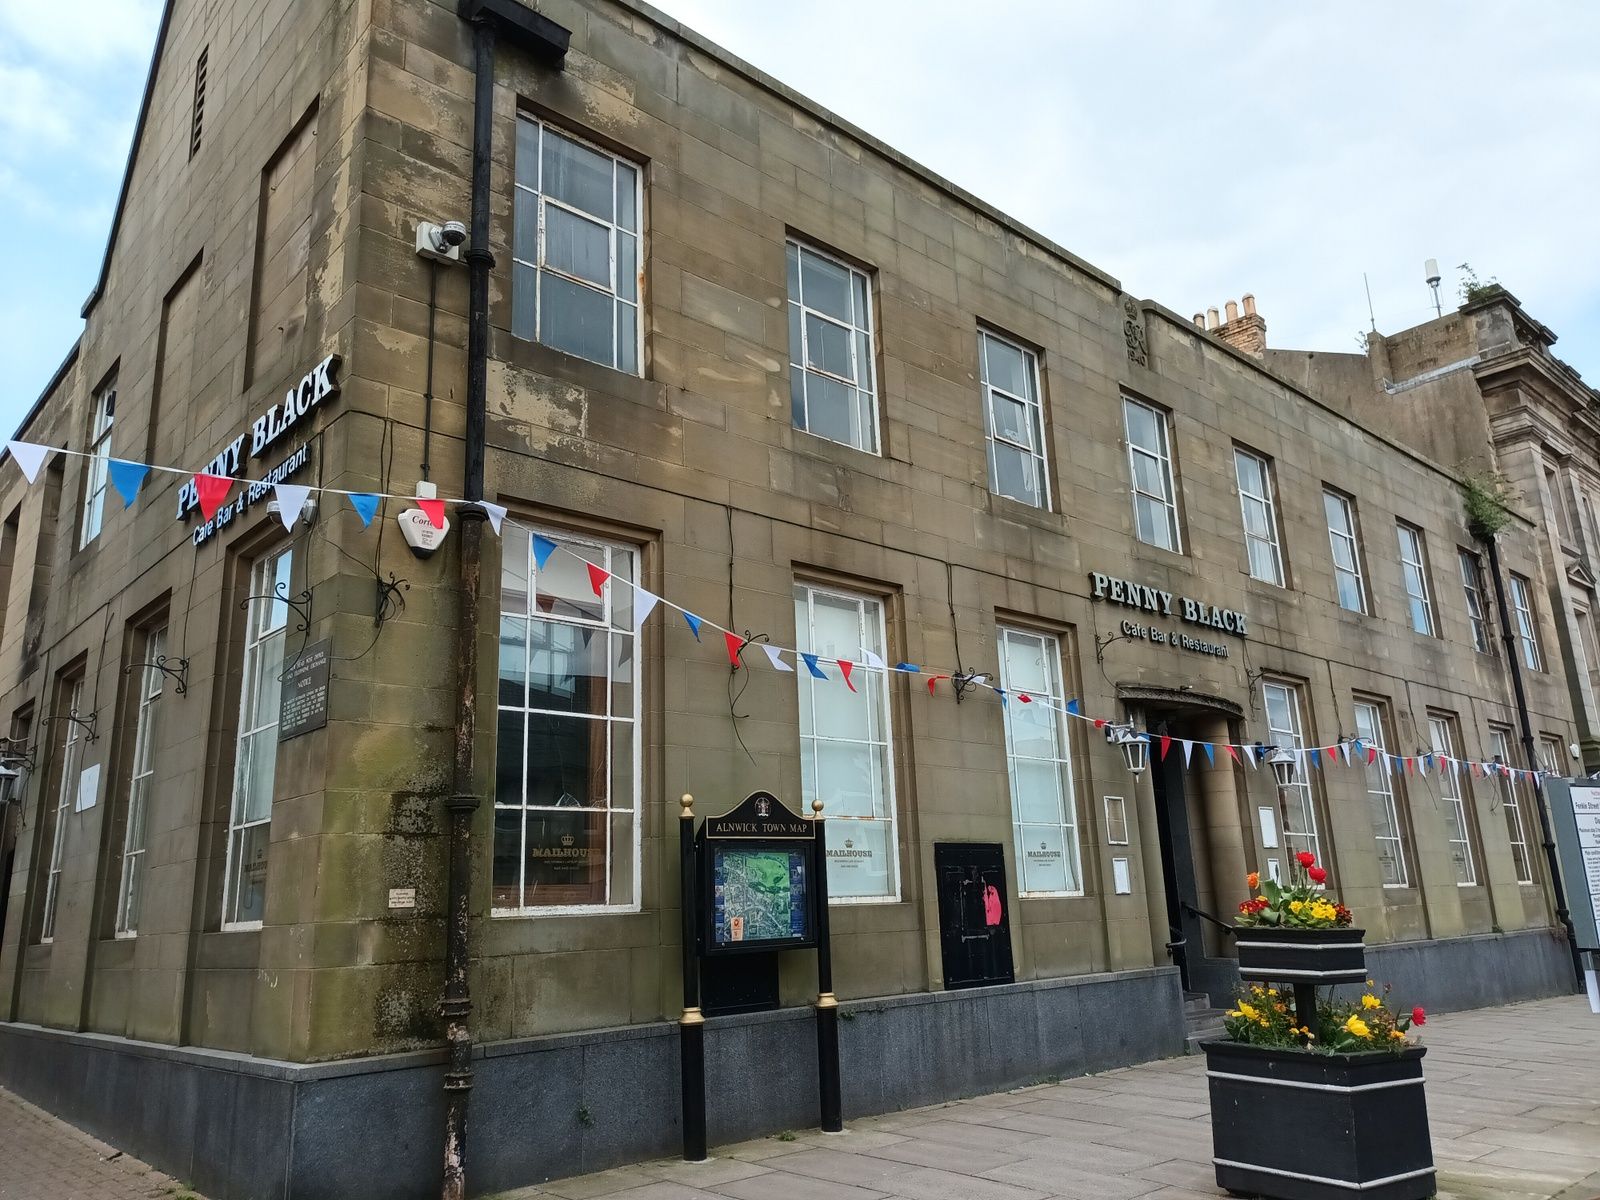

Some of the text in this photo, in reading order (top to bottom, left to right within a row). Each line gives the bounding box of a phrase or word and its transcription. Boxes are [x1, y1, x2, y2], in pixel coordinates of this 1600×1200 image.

[1127, 349, 1146, 367] 1940
[250, 353, 335, 458] BLACK
[216, 503, 234, 529] Bar
[236, 491, 244, 514] &
[248, 442, 308, 505] Restaurant
[1091, 572, 1249, 635] PENNY BLACK
[1122, 620, 1230, 657] Cafe Bar & Restaurant
[716, 823, 808, 834] ALNWICK TOWN MAP
[826, 849, 873, 858] MAILHOUSE
